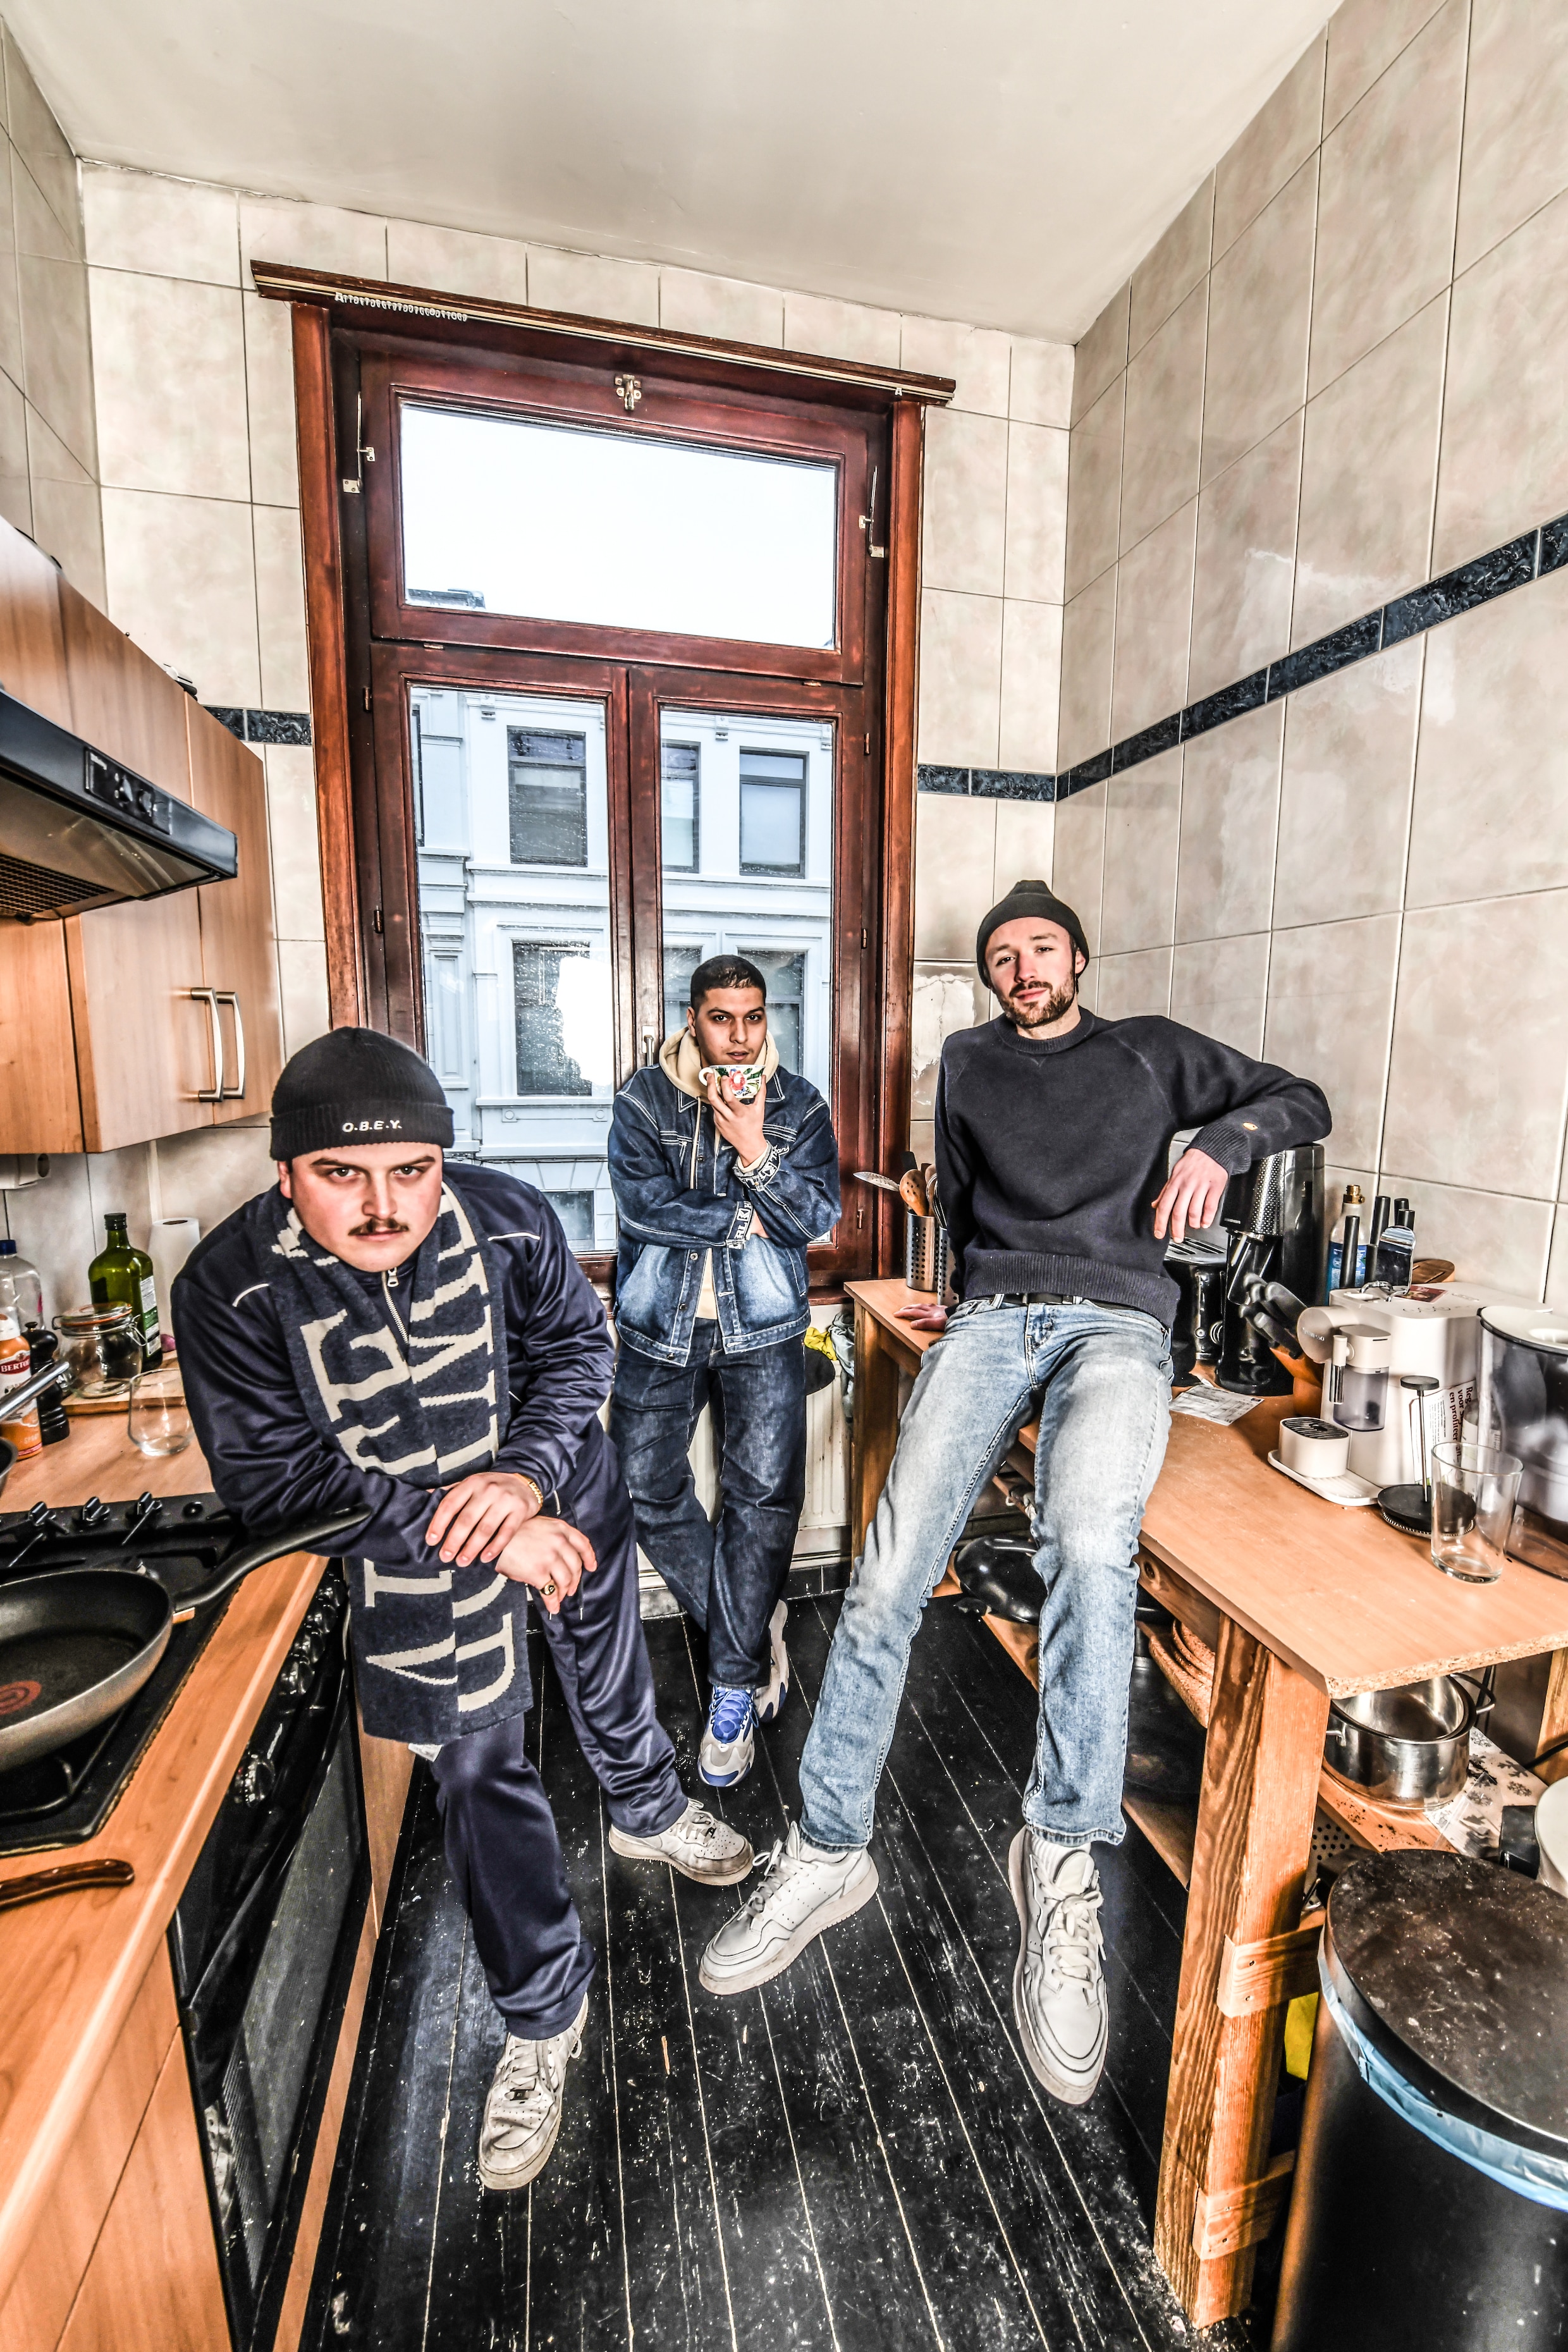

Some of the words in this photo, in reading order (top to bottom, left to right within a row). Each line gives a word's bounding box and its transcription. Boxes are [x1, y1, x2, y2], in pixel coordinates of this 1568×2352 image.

[1, 1359, 30, 1372] BERTO
[1449, 1392, 1455, 1403] en
[1465, 1387, 1473, 1404] Reg
[1450, 1404, 1460, 1441] profiteer
